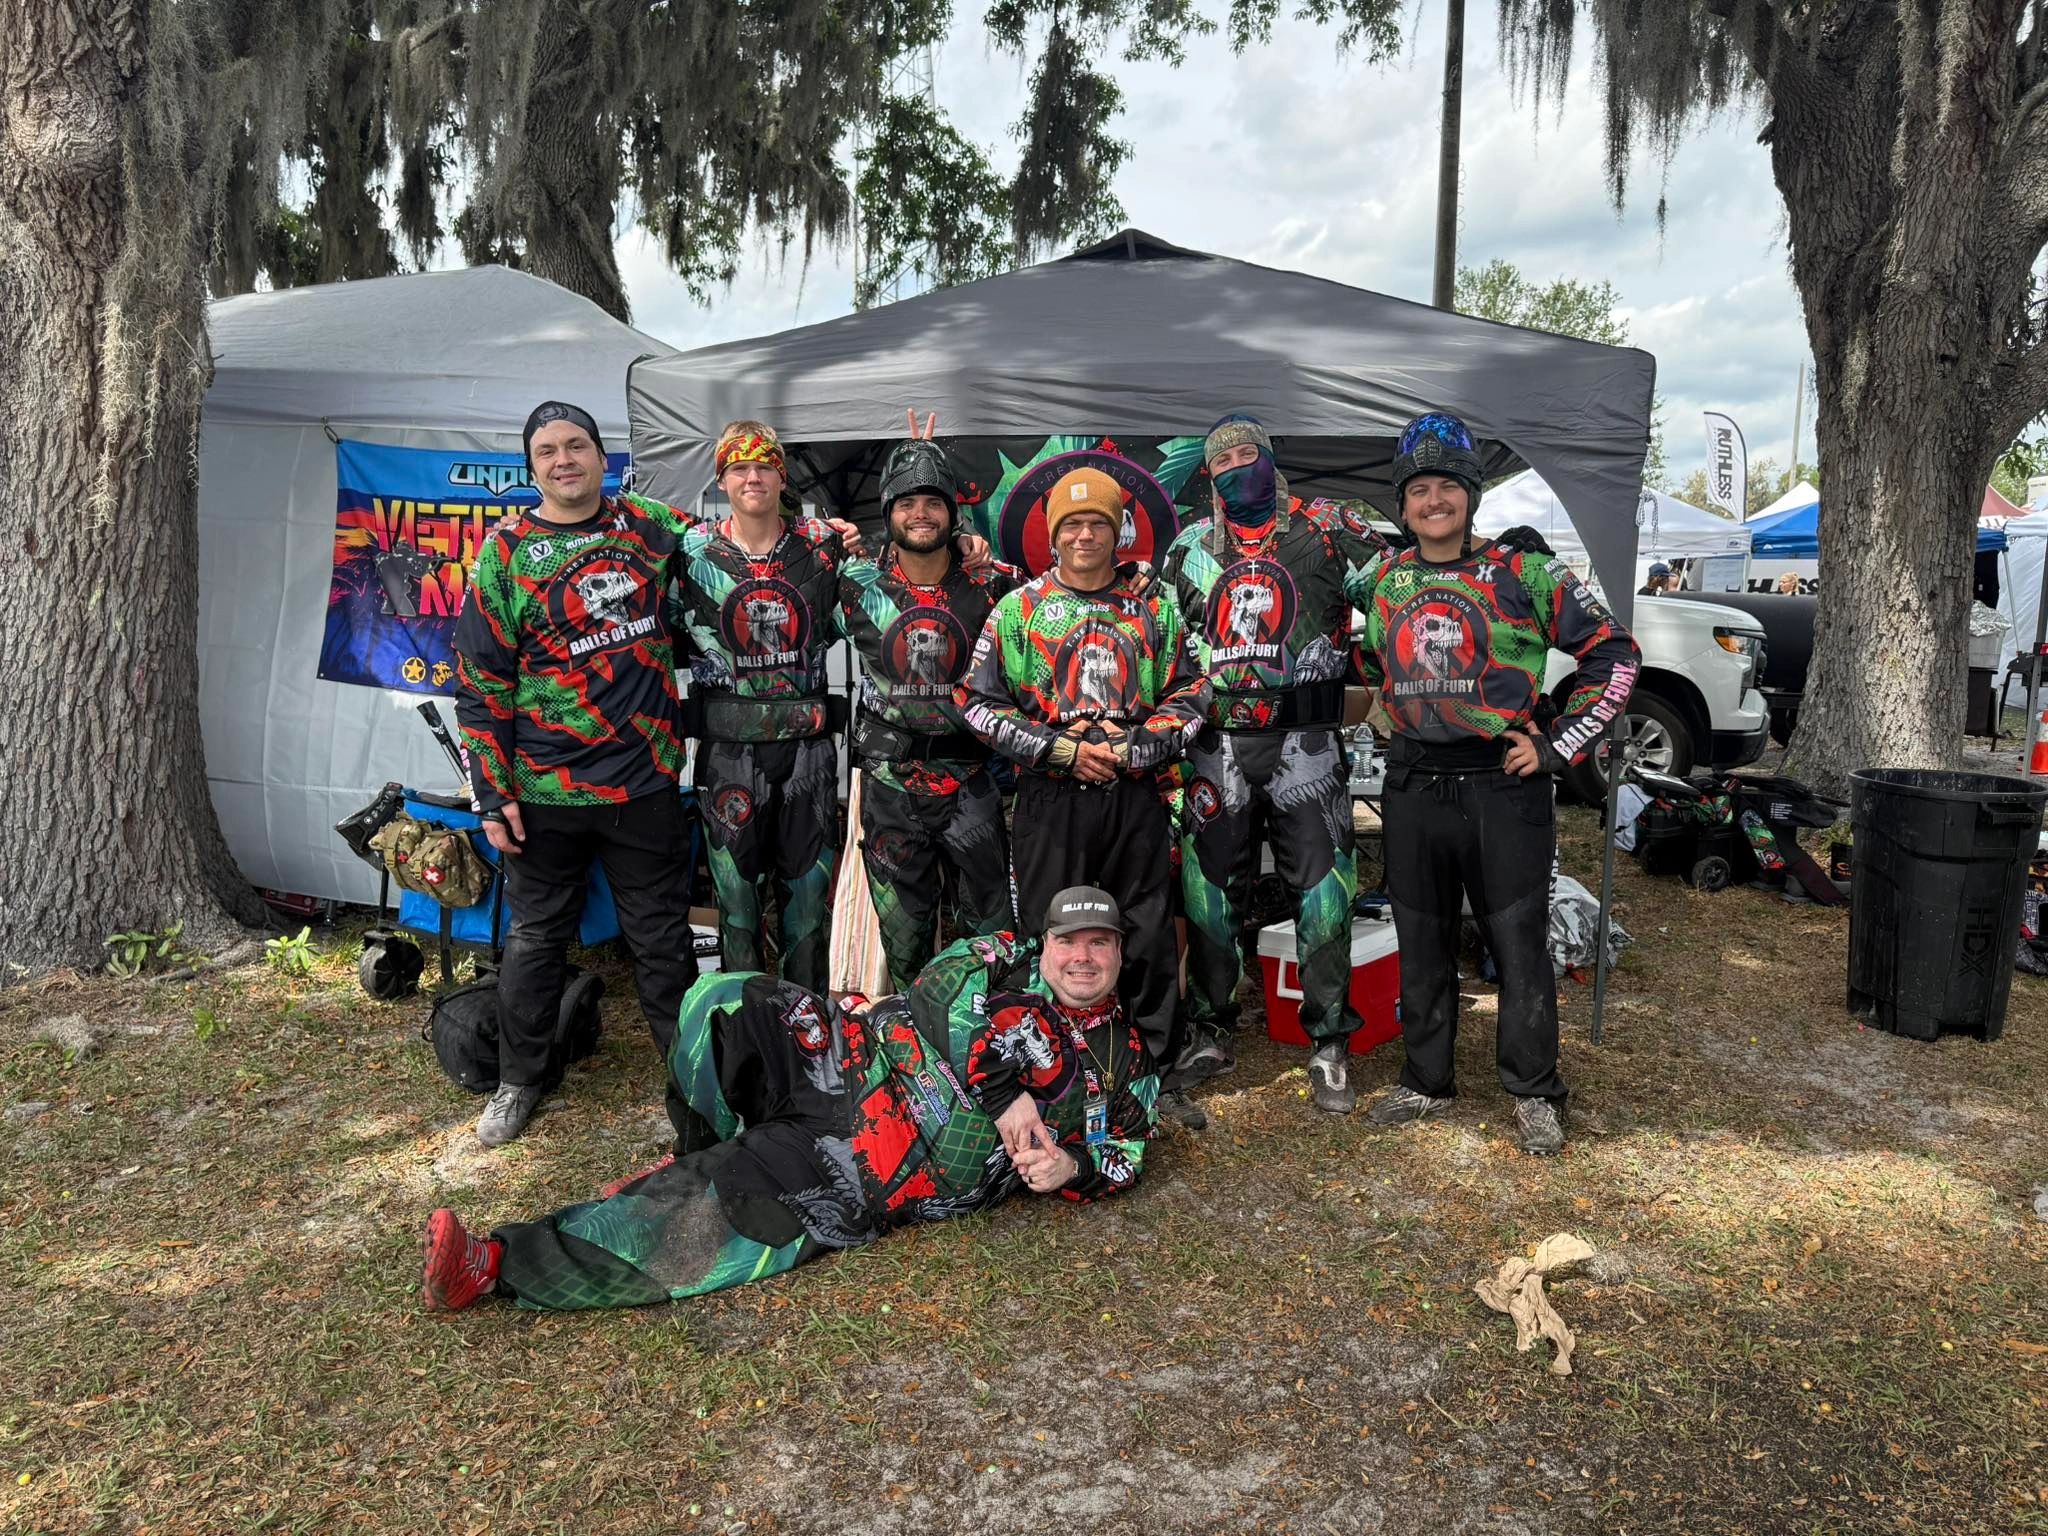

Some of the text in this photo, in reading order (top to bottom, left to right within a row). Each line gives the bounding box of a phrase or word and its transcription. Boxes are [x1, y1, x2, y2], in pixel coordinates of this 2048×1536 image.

[1717, 427, 1733, 500] RUTHLESS
[1029, 461, 1147, 495] T-REX NATION
[565, 532, 604, 551] RUTHLESS
[590, 549, 632, 561] NATION
[1421, 572, 1459, 583] RUTHLESS
[1401, 592, 1473, 616] T-REX NATION
[568, 614, 656, 656] BALLS OF FURY
[1091, 622, 1126, 645] NATION
[736, 649, 800, 668] BALLS OF FURY
[1211, 643, 1279, 662] BALLS OF FURY
[891, 684, 918, 696] BALLS
[919, 683, 930, 696] OF
[1394, 678, 1475, 696] BALLS OF FURY
[1552, 662, 1637, 761] BALLS OF FURY
[997, 719, 1017, 745] OF
[1083, 902, 1094, 910] OF
[693, 936, 718, 948] PRO
[1958, 906, 1994, 978] HDX
